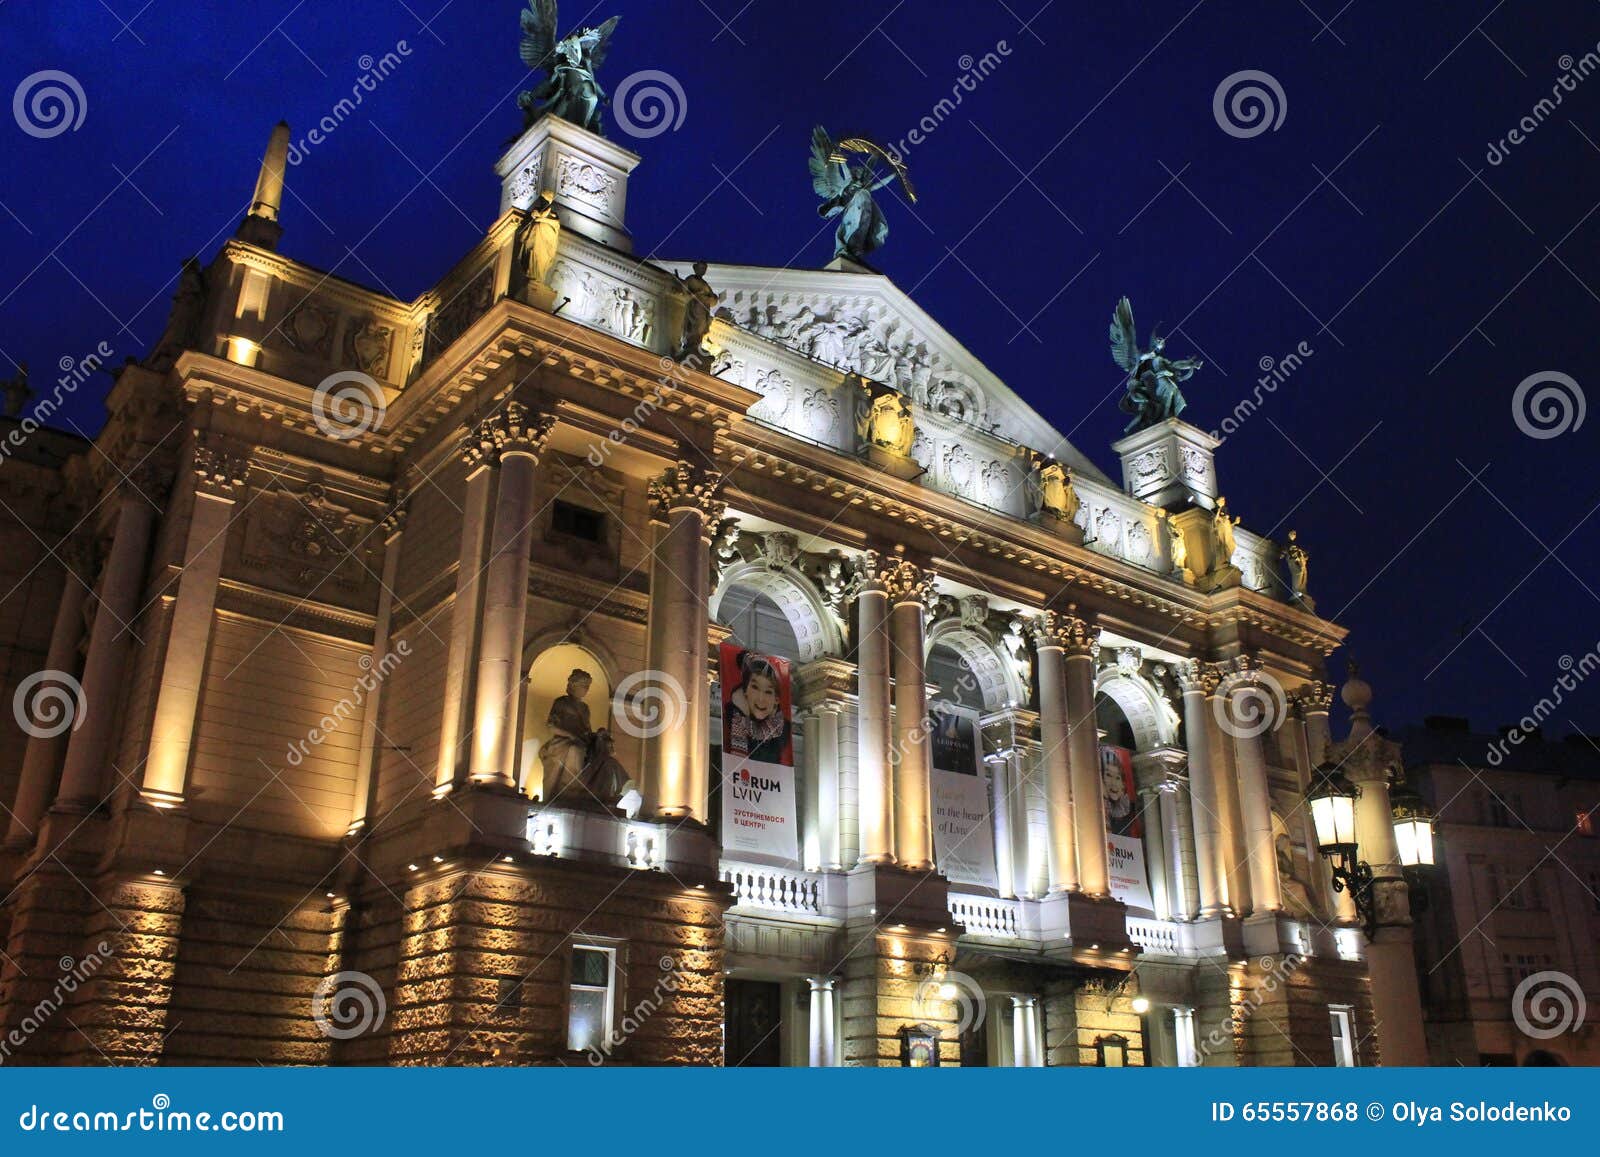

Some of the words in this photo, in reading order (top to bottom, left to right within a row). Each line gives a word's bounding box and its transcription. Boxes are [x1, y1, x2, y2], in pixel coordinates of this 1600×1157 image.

[733, 769, 781, 792] FORUM
[733, 786, 762, 803] LVIV
[936, 806, 945, 816] in
[947, 807, 960, 818] the
[938, 821, 948, 835] of
[1108, 842, 1134, 860] ORUM
[1109, 858, 1124, 869] VIV
